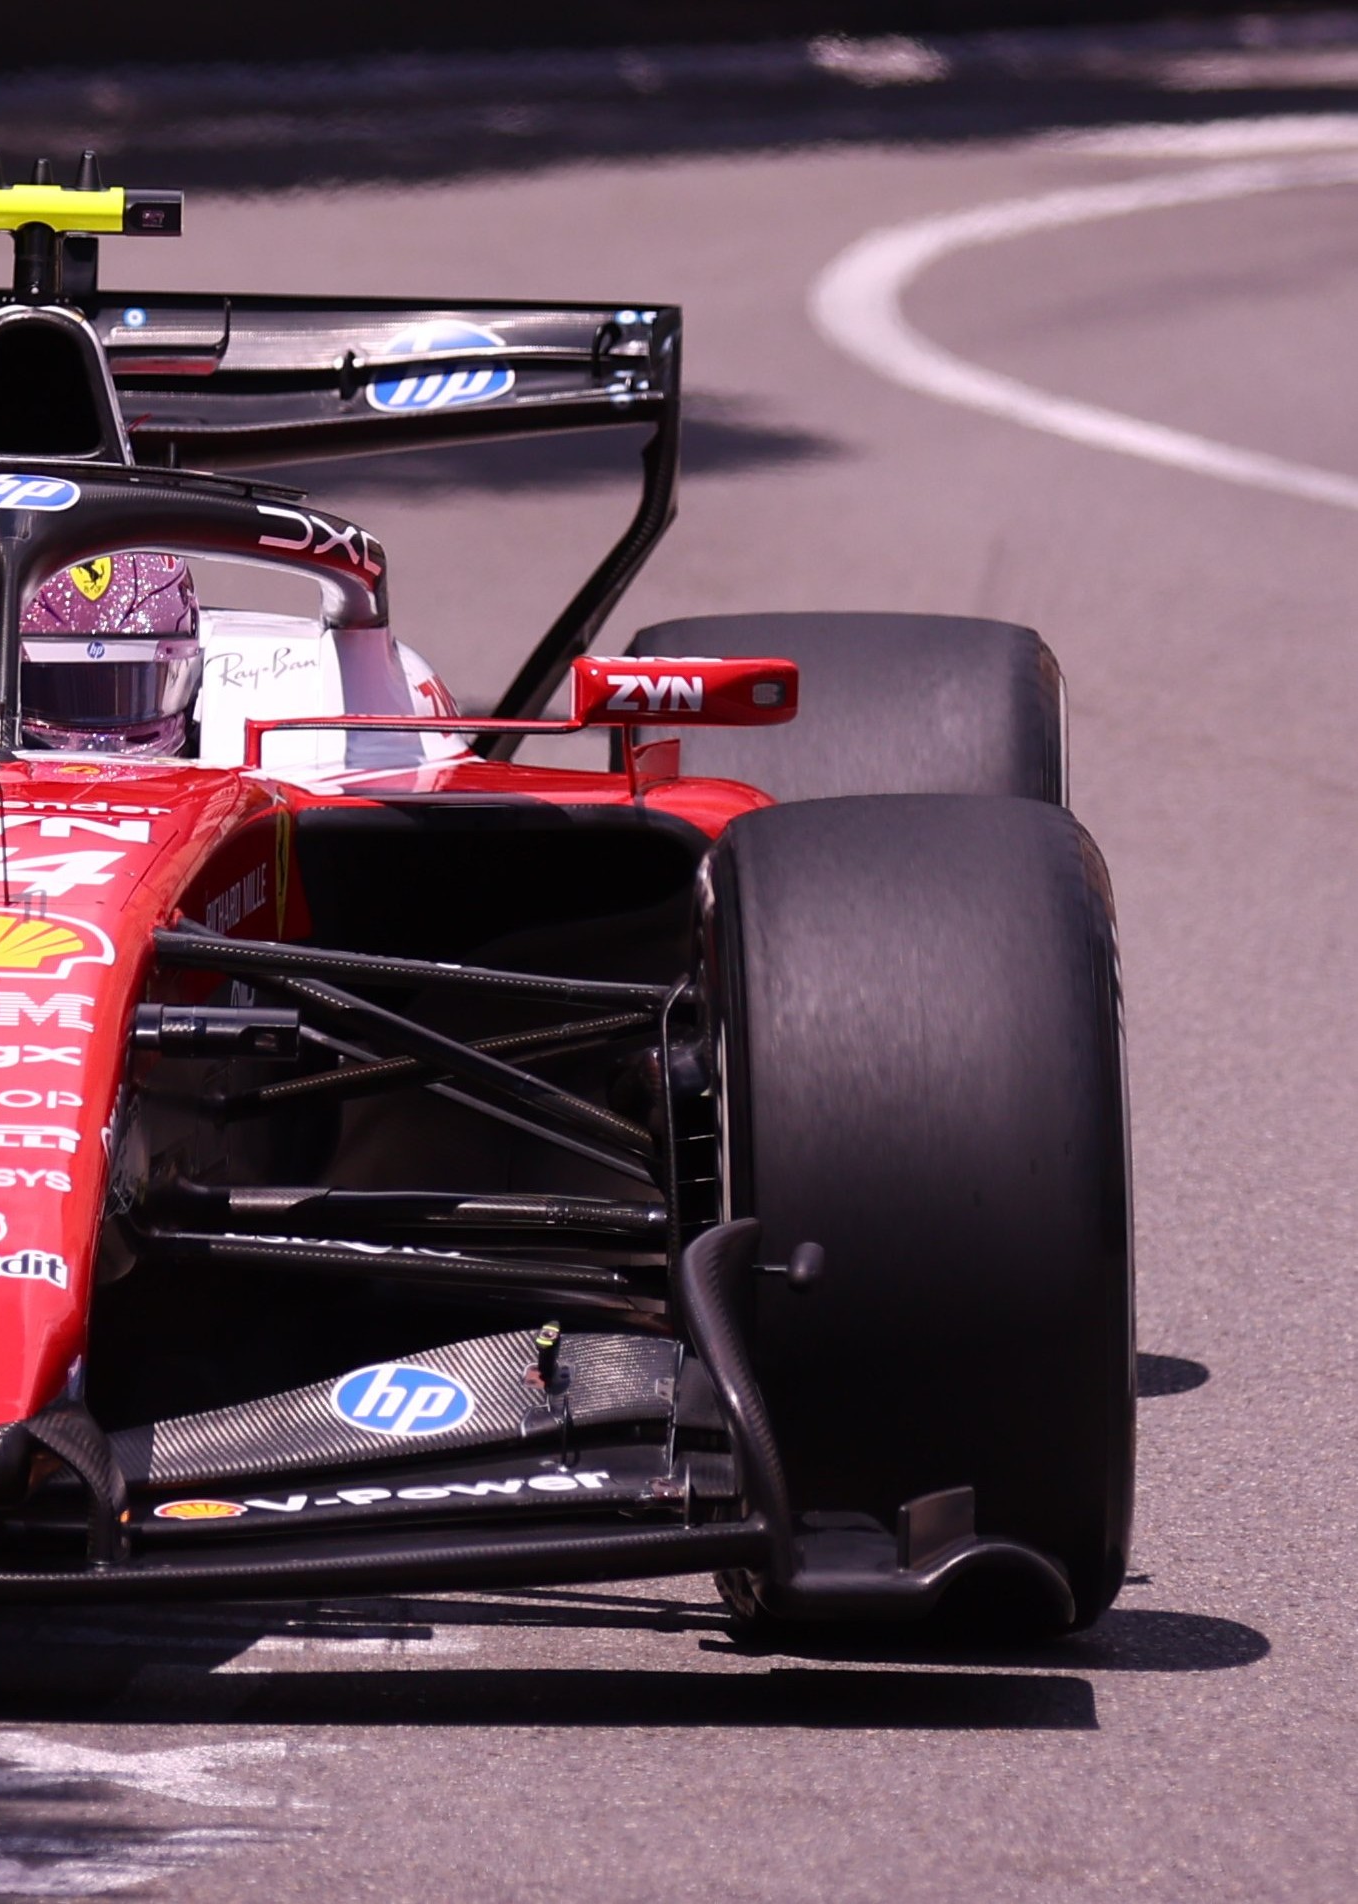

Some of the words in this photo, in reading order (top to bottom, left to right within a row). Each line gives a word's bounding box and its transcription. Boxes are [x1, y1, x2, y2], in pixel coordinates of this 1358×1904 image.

[89, 642, 105, 658] hp
[205, 647, 319, 688] Ray-Ban
[605, 674, 704, 712] ZYN
[352, 1366, 457, 1436] hp
[245, 1467, 610, 1514] V-Power
